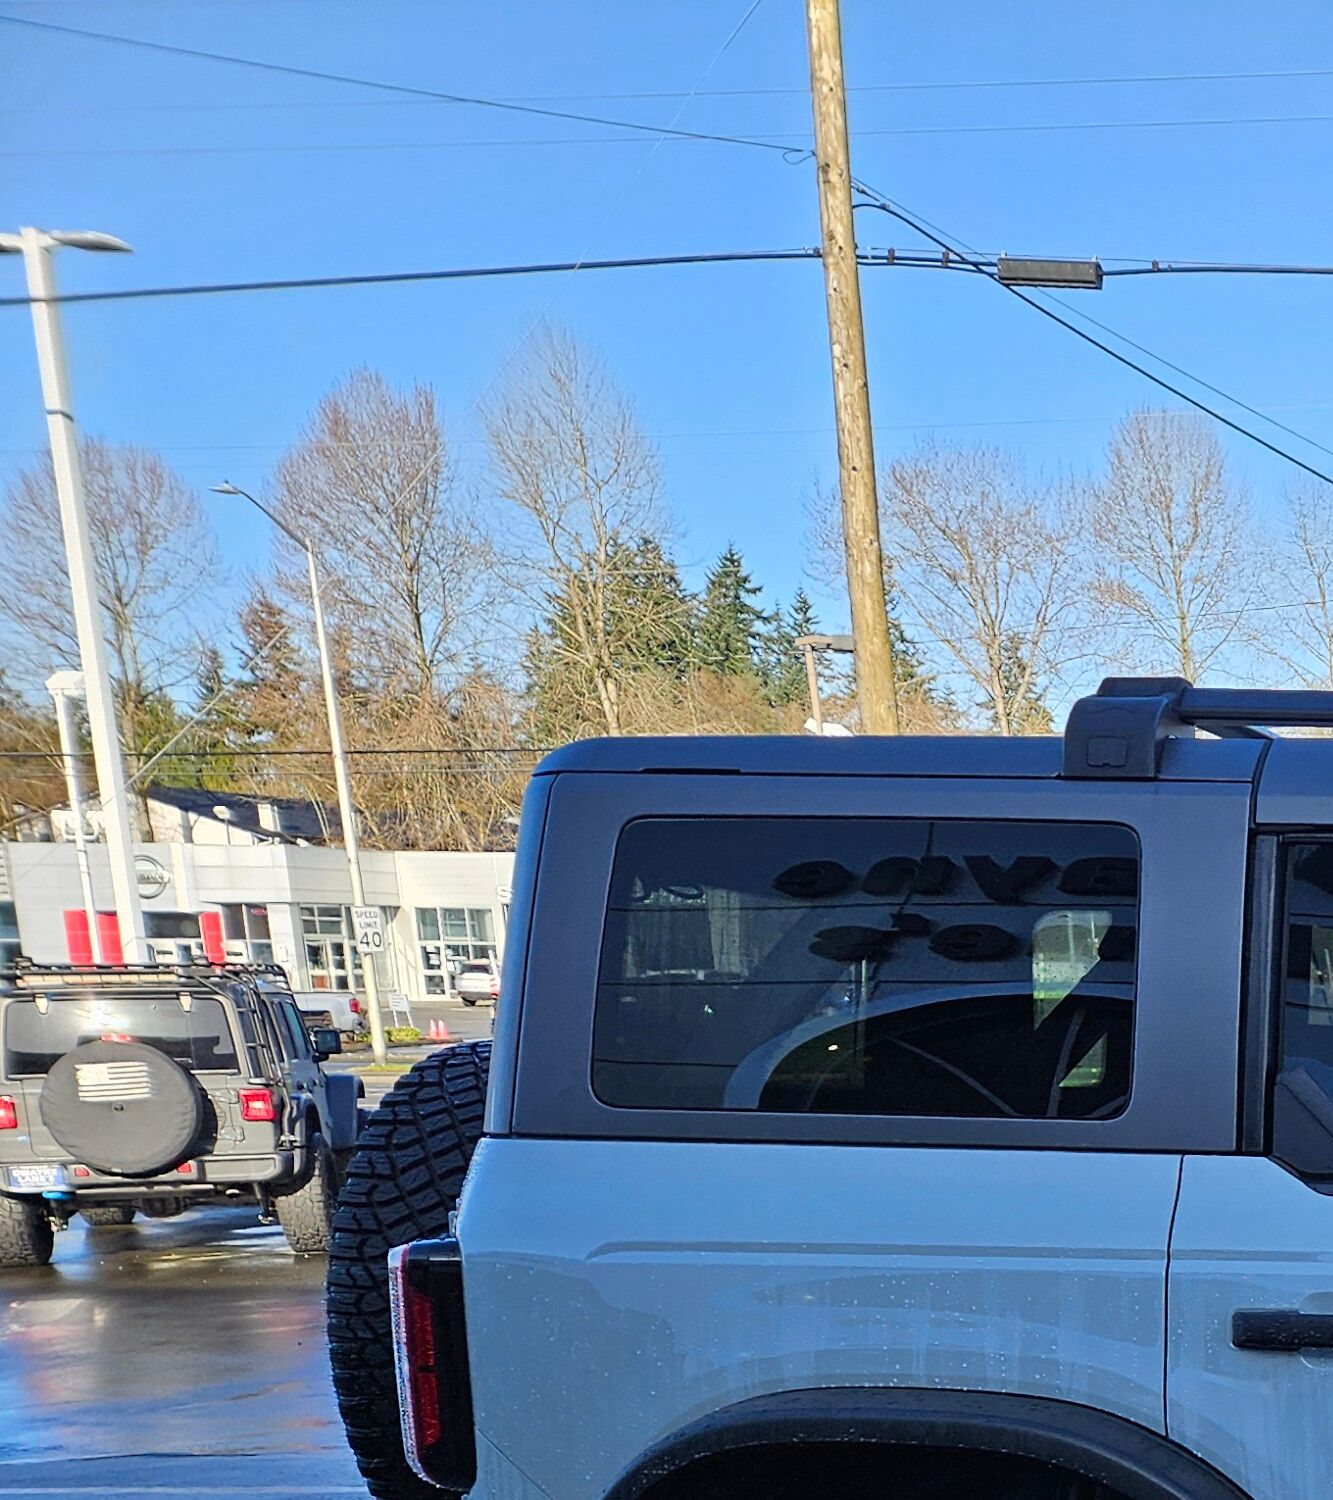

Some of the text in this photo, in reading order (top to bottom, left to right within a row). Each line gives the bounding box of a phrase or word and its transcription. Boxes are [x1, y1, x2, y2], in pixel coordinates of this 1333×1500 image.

[355, 910, 379, 919] SPEED
[358, 921, 378, 929] LIMIT
[360, 931, 382, 948] 40
